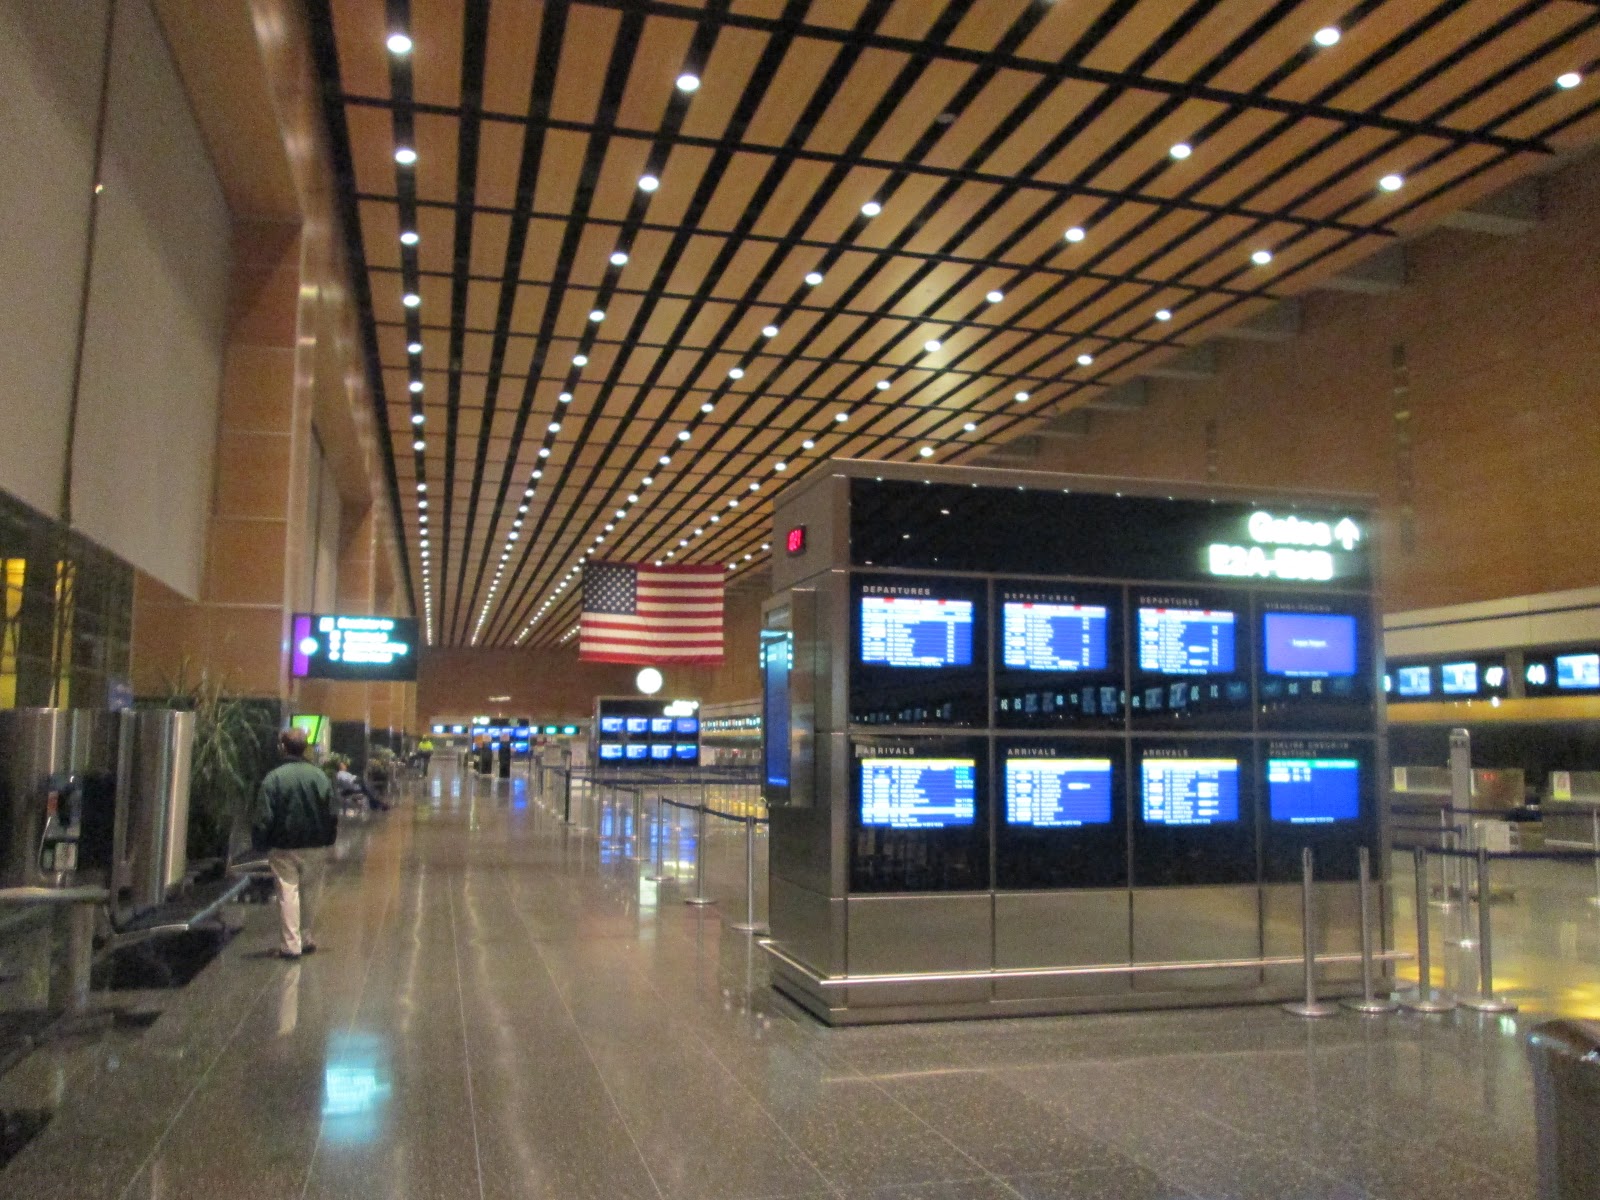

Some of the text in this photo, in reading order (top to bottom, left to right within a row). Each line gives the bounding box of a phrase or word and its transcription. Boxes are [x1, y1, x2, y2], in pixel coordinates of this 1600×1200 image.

[862, 585, 931, 596] DEPARTURES
[1004, 592, 1076, 602] DEPARTURES
[1140, 596, 1199, 606] DEPARTURES
[863, 747, 915, 755] ARRIVALS
